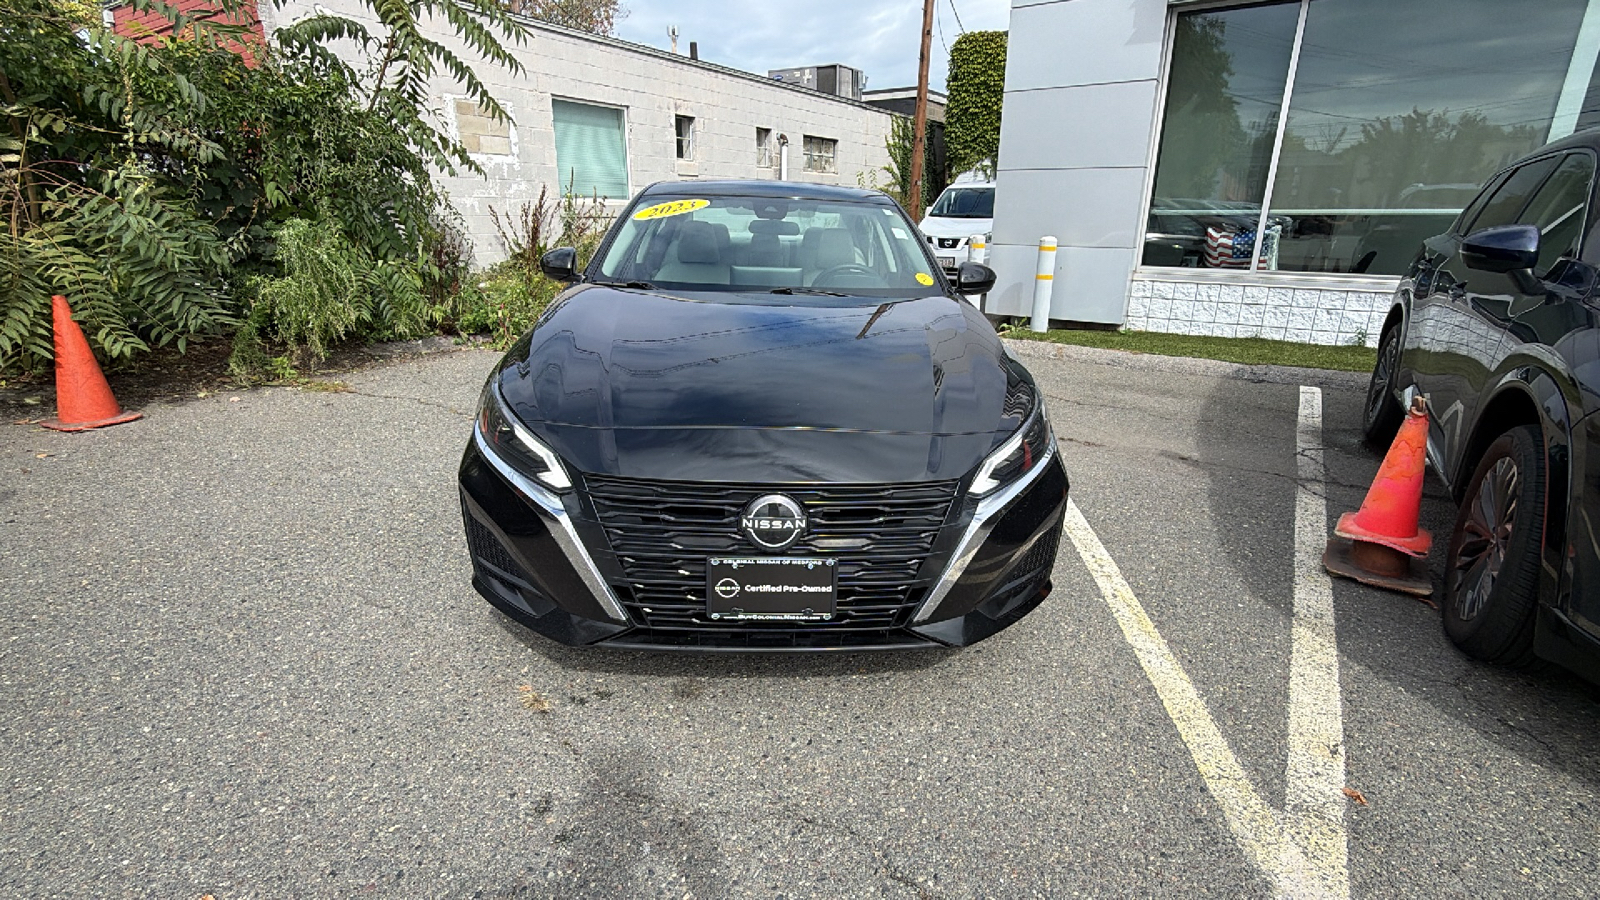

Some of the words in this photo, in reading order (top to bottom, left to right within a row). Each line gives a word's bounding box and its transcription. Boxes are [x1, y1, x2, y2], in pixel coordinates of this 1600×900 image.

[648, 201, 696, 217] 2023
[742, 518, 806, 529] NISSAN
[744, 584, 782, 593] Certified
[783, 584, 832, 593] Pre-Owned
